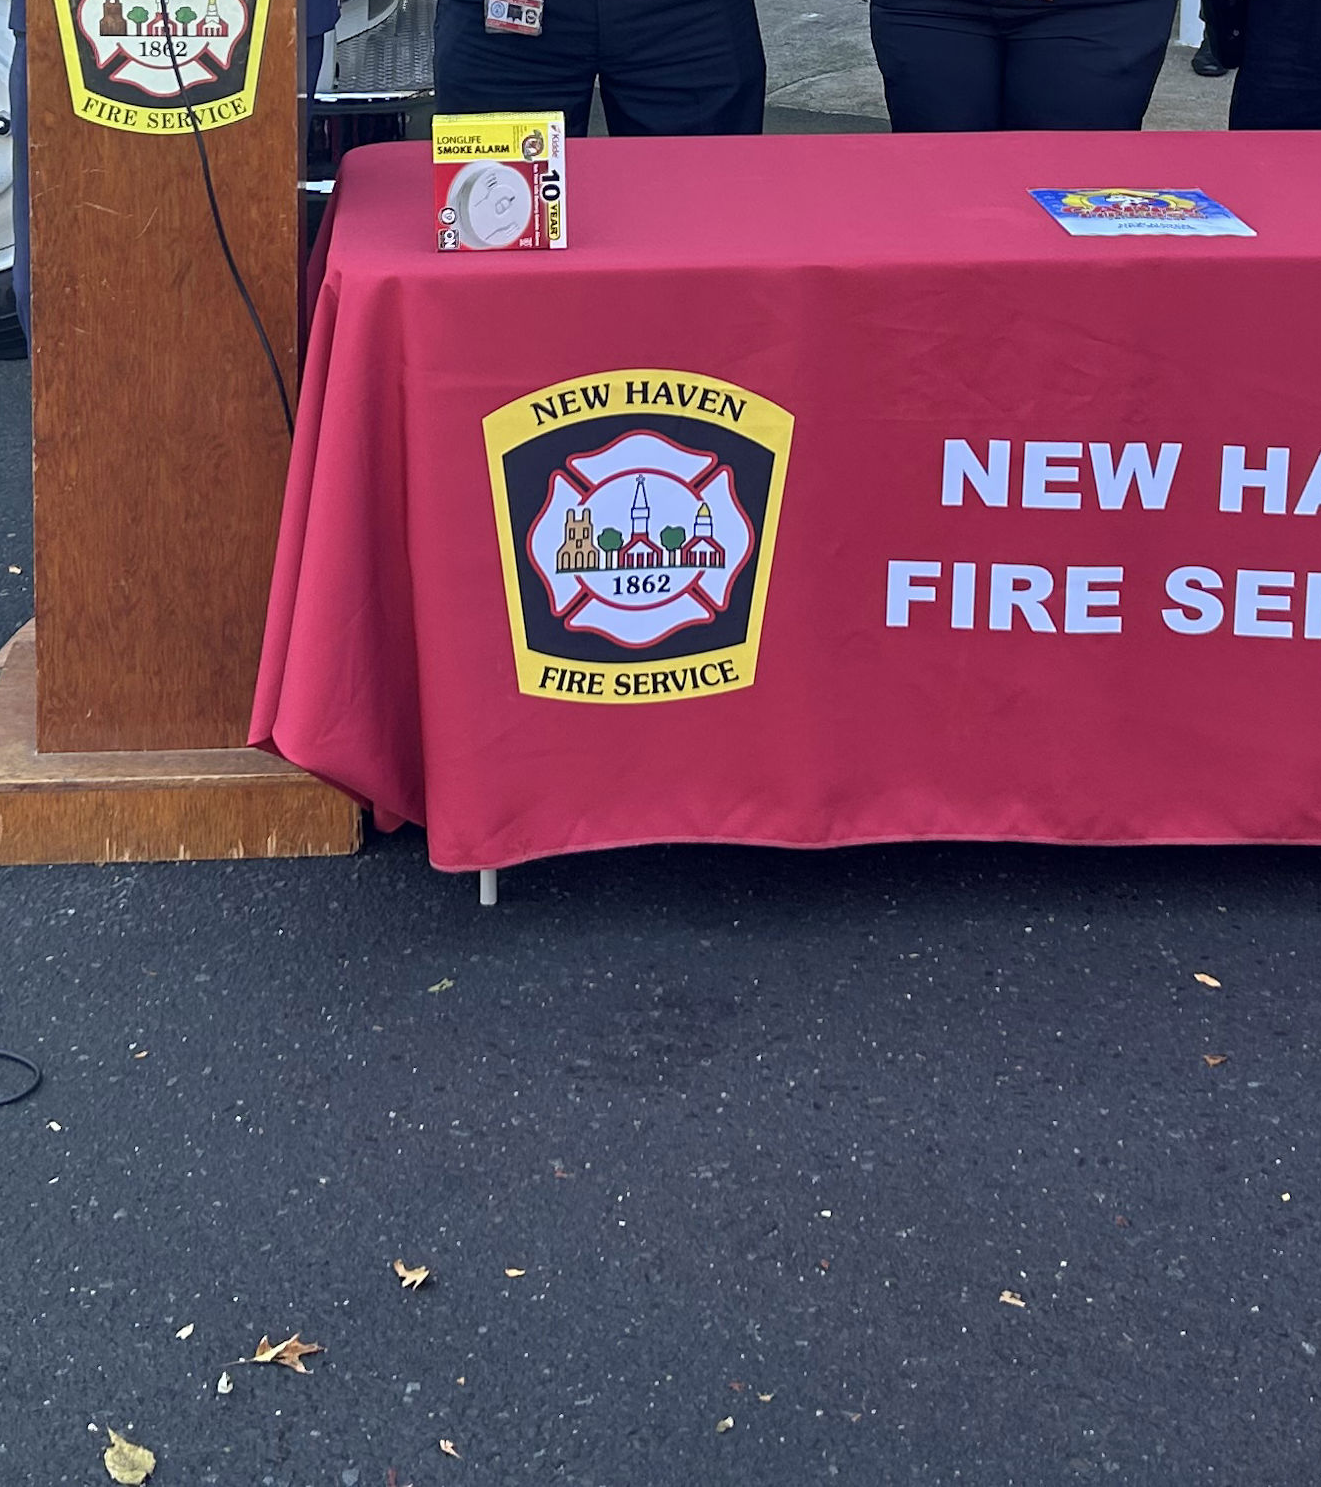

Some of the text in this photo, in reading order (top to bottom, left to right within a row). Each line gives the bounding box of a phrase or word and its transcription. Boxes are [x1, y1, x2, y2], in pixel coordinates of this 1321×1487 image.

[81, 97, 247, 129] FIRE SERVICE
[436, 135, 482, 145] LONGLIFE
[437, 144, 510, 155] SMOKE ALARM
[542, 170, 561, 235] 10 YEAR
[444, 230, 456, 249] ON
[530, 381, 747, 426] NEW HAVEN
[941, 438, 1182, 511] NEW
[612, 574, 671, 595] 1862
[885, 559, 1124, 634] FIRE
[538, 659, 740, 696] FIRE SERVICE
